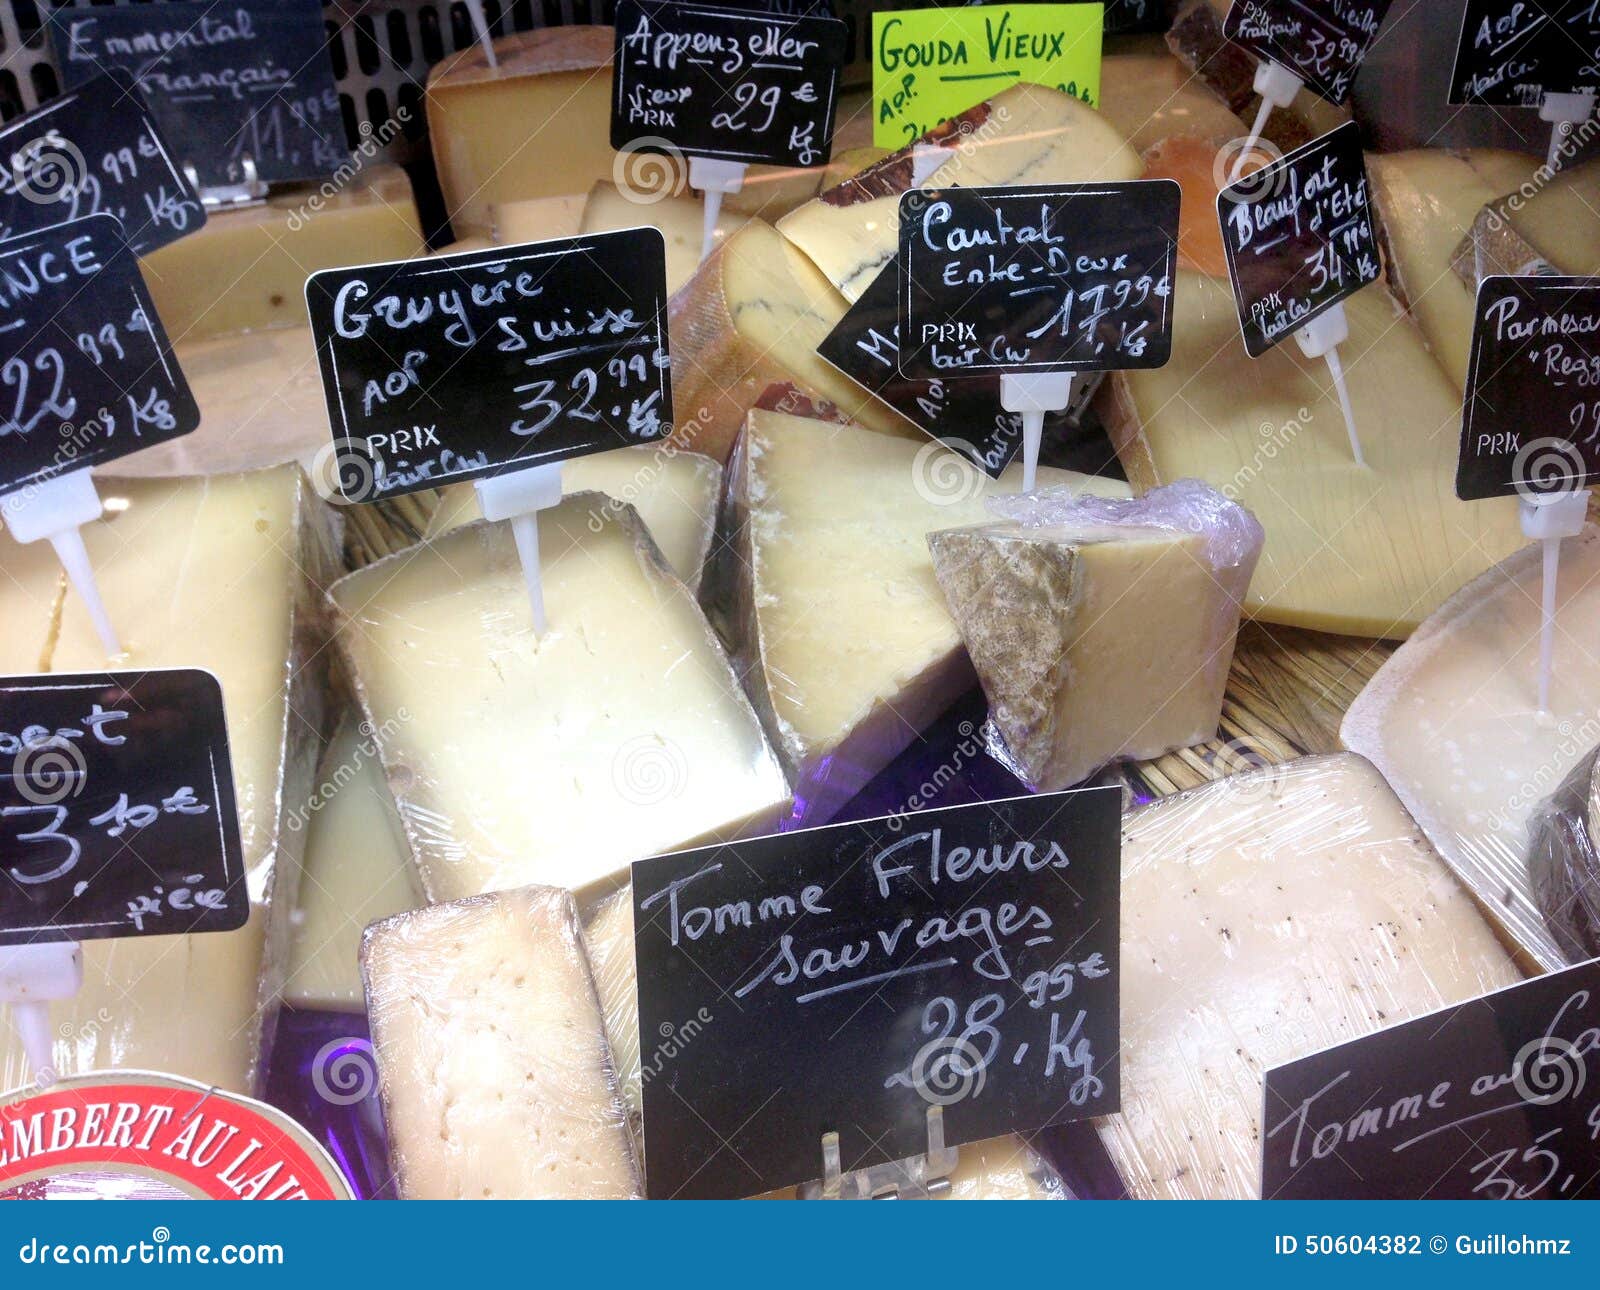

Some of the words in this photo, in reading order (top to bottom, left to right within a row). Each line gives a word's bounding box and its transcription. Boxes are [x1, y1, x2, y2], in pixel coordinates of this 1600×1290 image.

[625, 15, 819, 74] Appenzeller
[879, 18, 968, 73] GOUDA
[629, 108, 676, 128] PRIX
[922, 202, 1065, 252] Cantal
[0, 235, 101, 309] NCE
[922, 321, 978, 345] PRIX
[1252, 290, 1282, 322] PRIX
[366, 424, 442, 458] PRIX
[1476, 431, 1521, 457] PRIX
[641, 862, 832, 946] Tomme
[872, 828, 1070, 899] Fleurs
[1044, 1009, 1104, 1106] Kg
[162, 1112, 240, 1169] AU
[1266, 1070, 1451, 1168] Tomme
